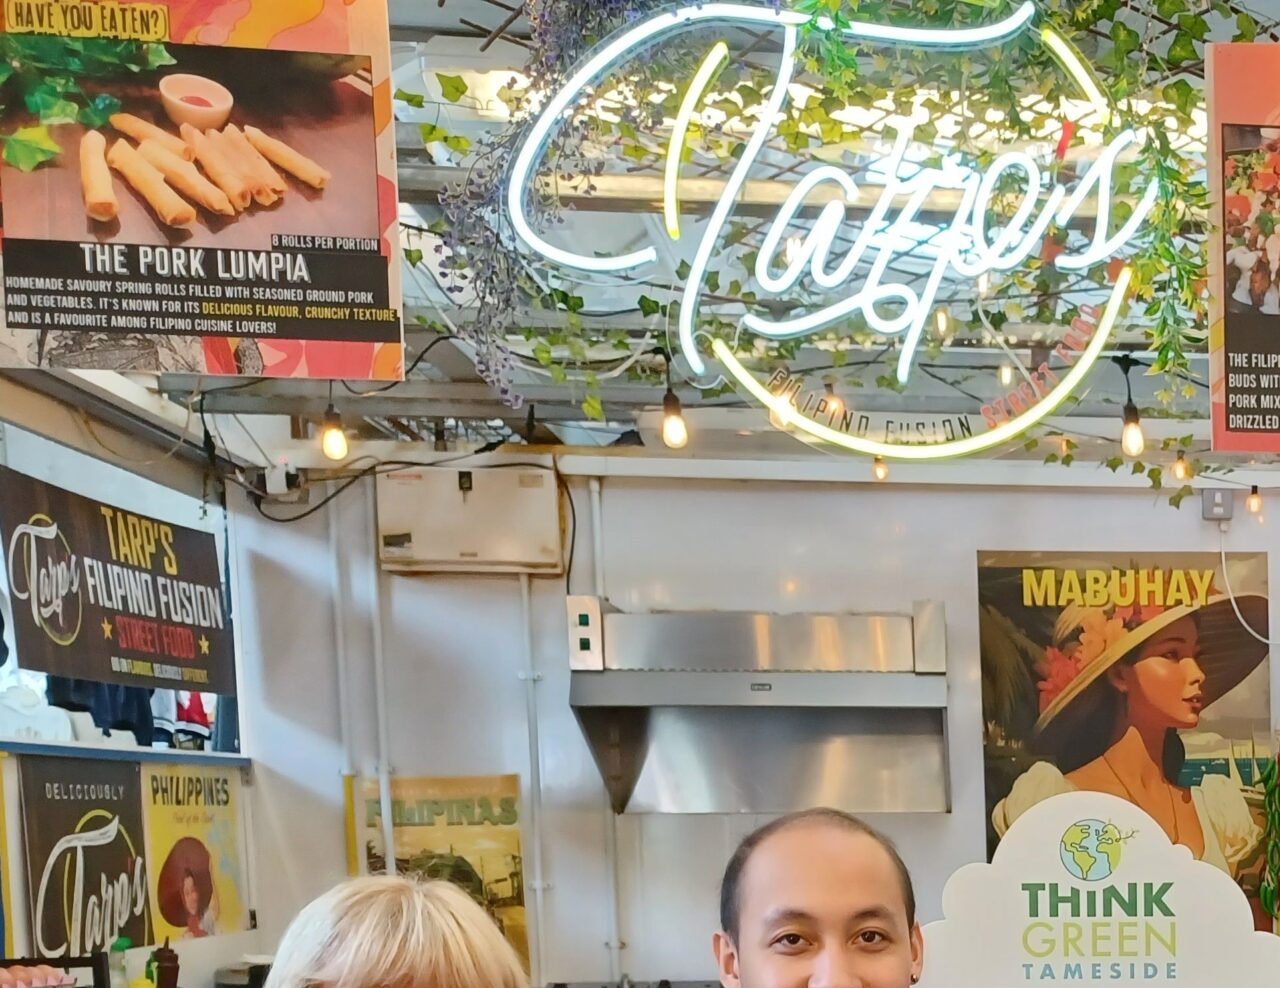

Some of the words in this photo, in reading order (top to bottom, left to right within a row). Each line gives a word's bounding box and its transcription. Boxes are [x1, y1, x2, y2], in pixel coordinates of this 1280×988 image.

[60, 5, 93, 30] YOU
[273, 235, 278, 245] 8
[282, 236, 312, 248] ROLLS
[315, 238, 333, 249] PER
[336, 238, 377, 250] PORTION
[80, 243, 130, 275] THE
[139, 246, 206, 278] PORK
[217, 250, 311, 283] LUMPIA
[6, 276, 64, 290] HOMEMADE
[67, 279, 112, 292] SAVOURY
[116, 281, 151, 294] SPRING
[155, 283, 186, 296] ROLLS
[189, 284, 222, 297] FILLED
[225, 286, 250, 298] WITH
[253, 287, 303, 301] SEASONED
[306, 290, 345, 303] GROUND
[348, 292, 373, 304] PORK
[1228, 353, 1249, 368] THE
[766, 368, 871, 437] FILIPINO
[884, 415, 973, 445] FUSION
[979, 362, 1060, 431] STREET
[101, 505, 178, 575] TARP'S
[83, 557, 157, 619] FILIPINO
[157, 576, 224, 629] FUSION
[1021, 569, 1215, 608] MABUHAY
[116, 615, 159, 652] STREET
[163, 625, 194, 659] FOOD
[45, 782, 125, 800] DELICIOUSLY
[151, 775, 230, 806] PHILIPPINES
[1021, 921, 1176, 957] GREEN
[1022, 963, 1177, 980] TAMESIDE
